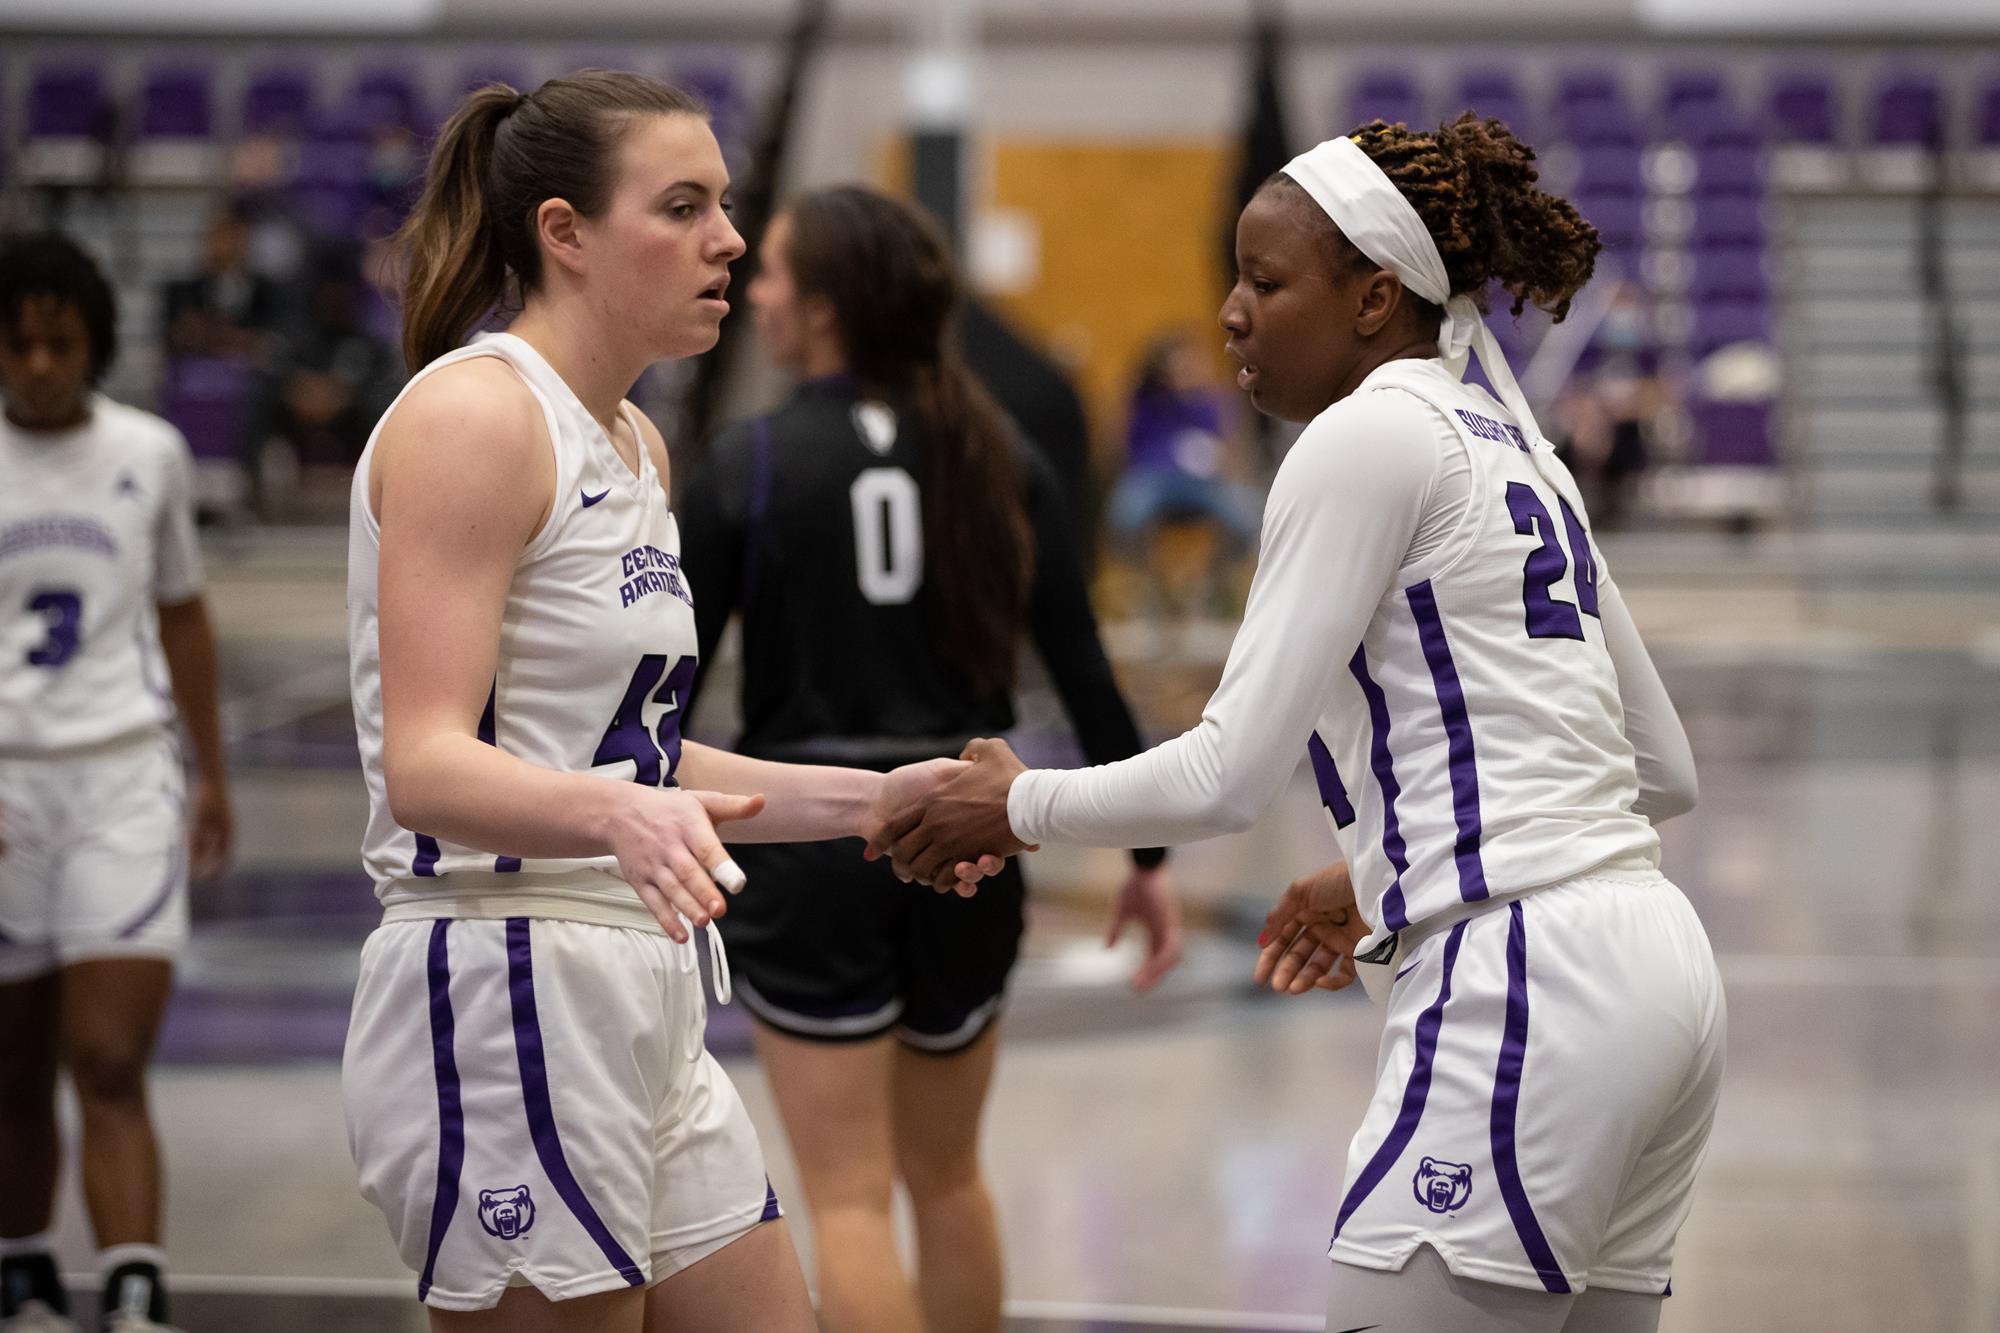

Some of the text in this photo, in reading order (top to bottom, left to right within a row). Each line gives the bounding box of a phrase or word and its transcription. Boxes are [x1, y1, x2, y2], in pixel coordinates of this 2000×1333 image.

[620, 544, 681, 580] CETRA
[850, 467, 925, 605] 0
[26, 587, 84, 669] 3
[591, 653, 698, 788] 42
